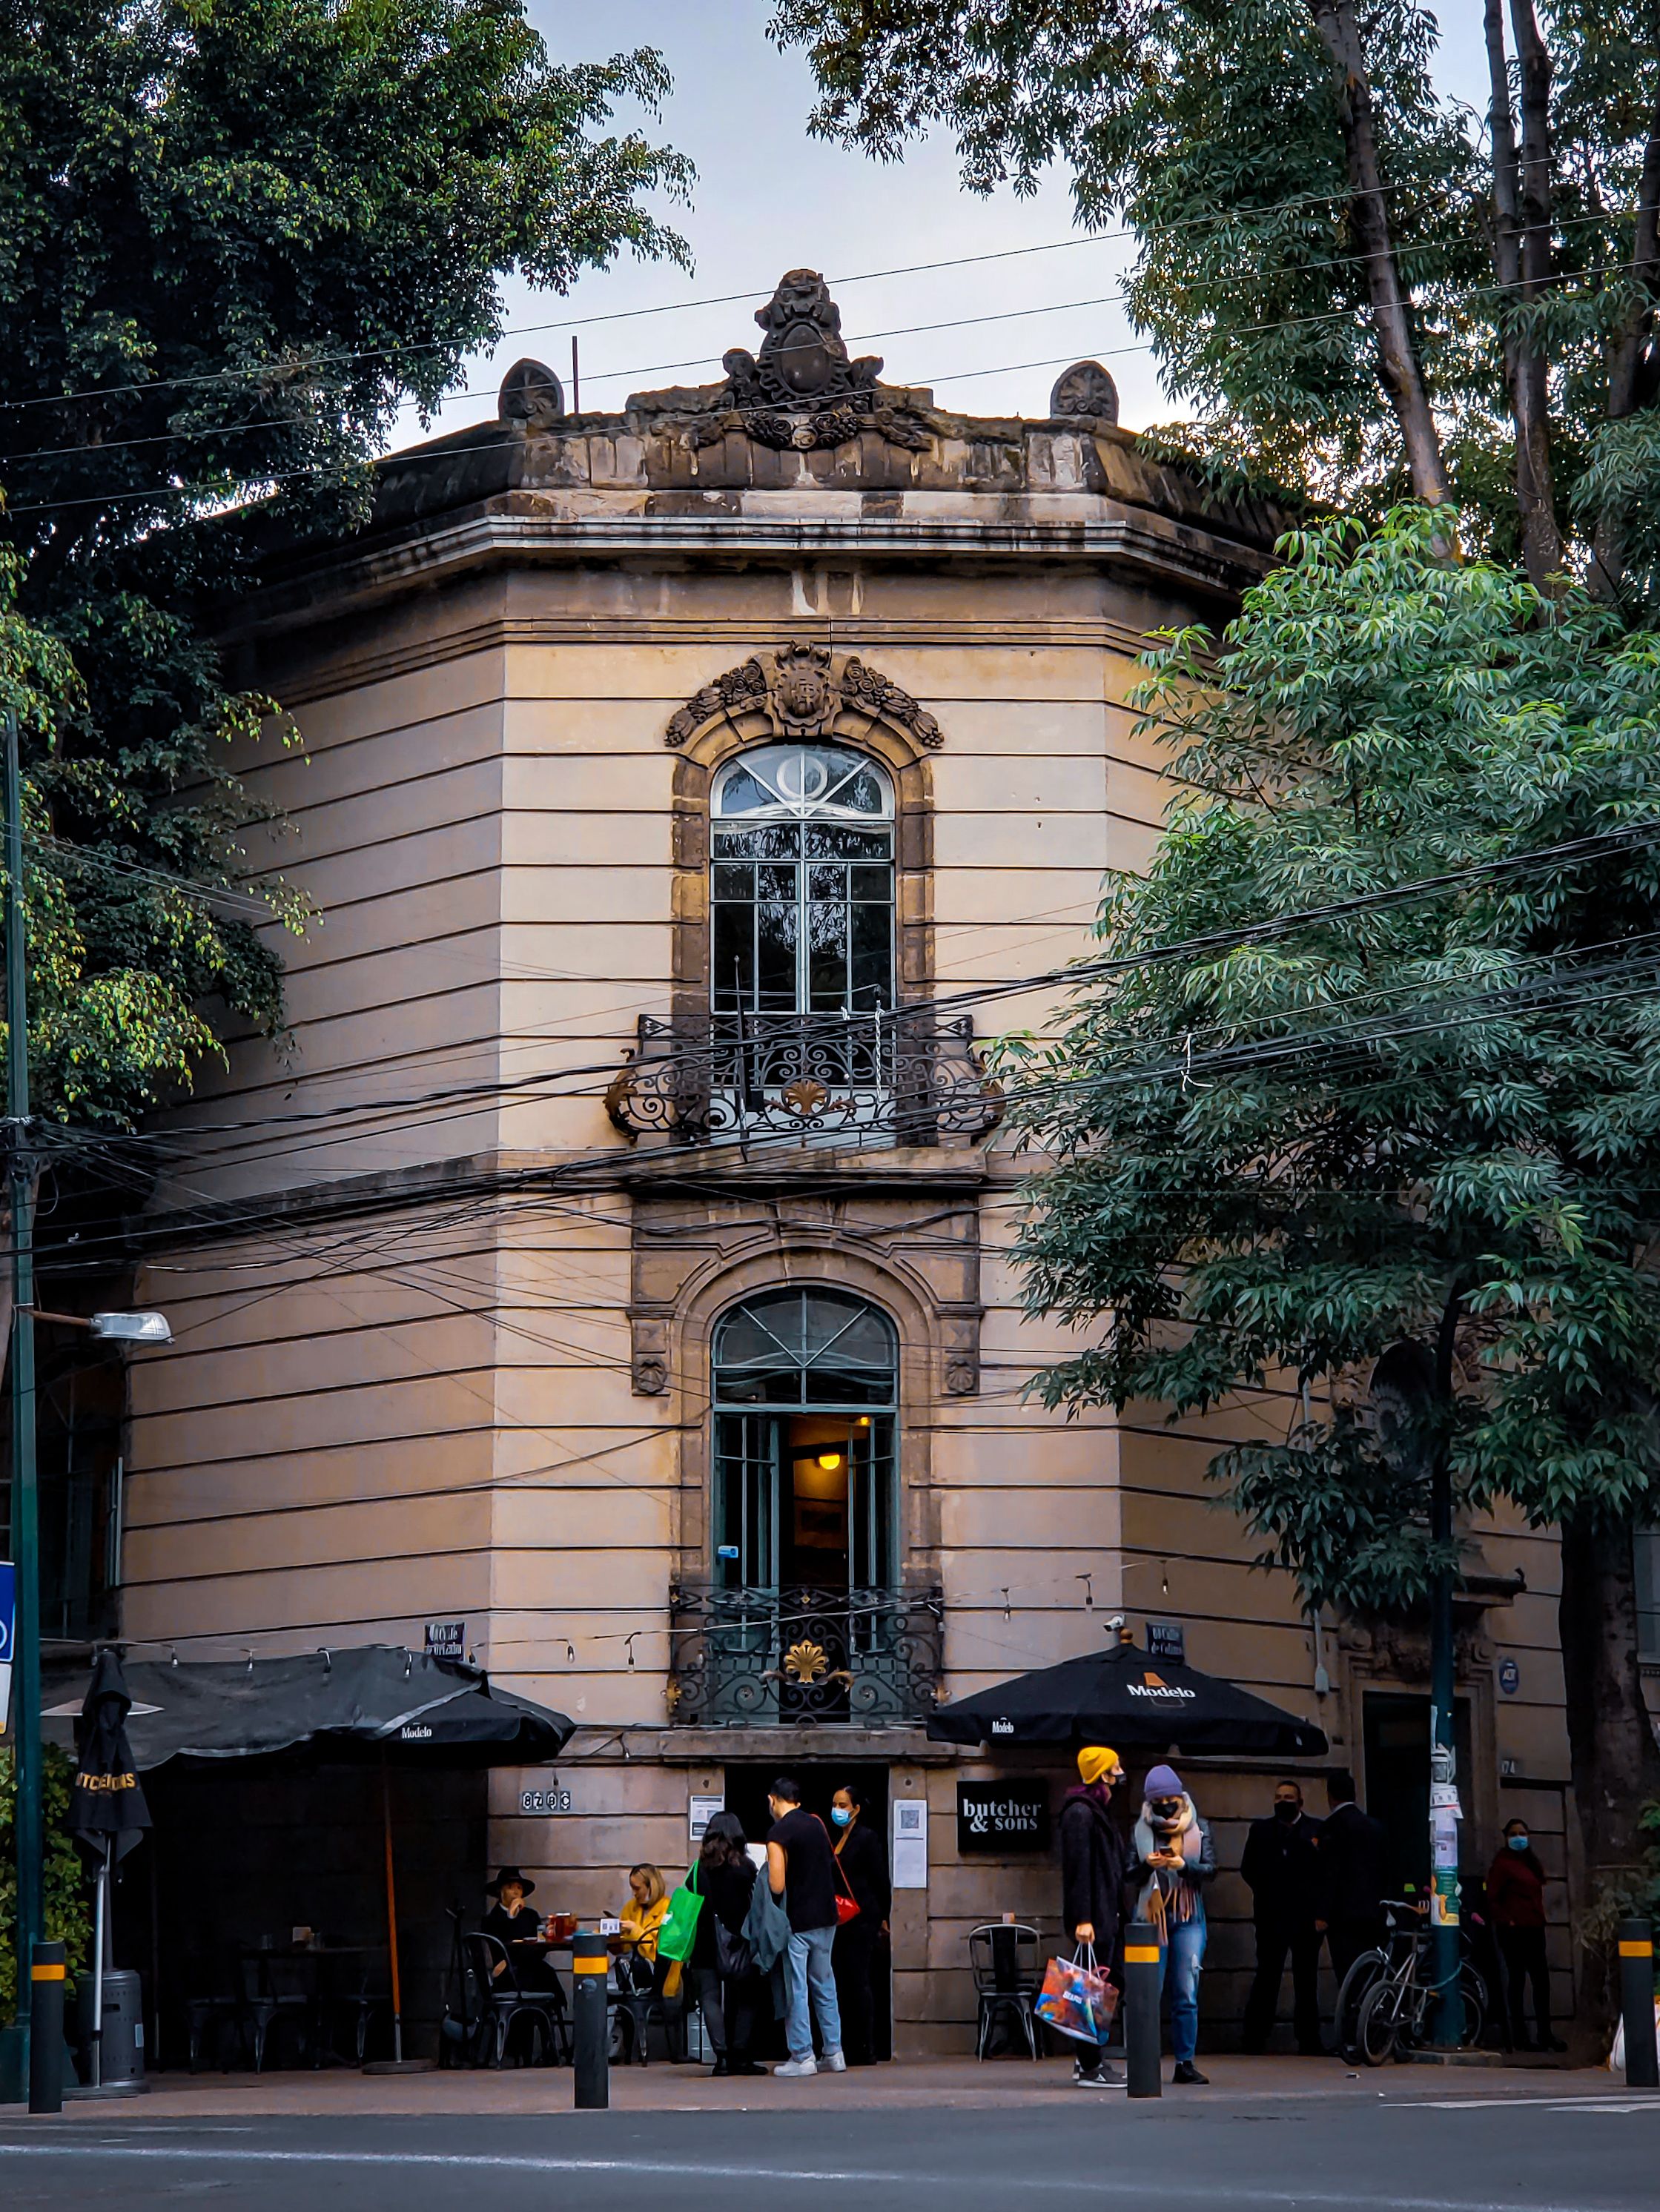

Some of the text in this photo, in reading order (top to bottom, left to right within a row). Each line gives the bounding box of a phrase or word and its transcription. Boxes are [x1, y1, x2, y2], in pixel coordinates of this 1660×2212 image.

[1126, 1683, 1196, 1698] Modelo
[402, 1726, 431, 1739] Modelo
[992, 1721, 1014, 1733] Modelo
[963, 1798, 1042, 1817] butcher
[970, 1814, 1038, 1832] & sons
